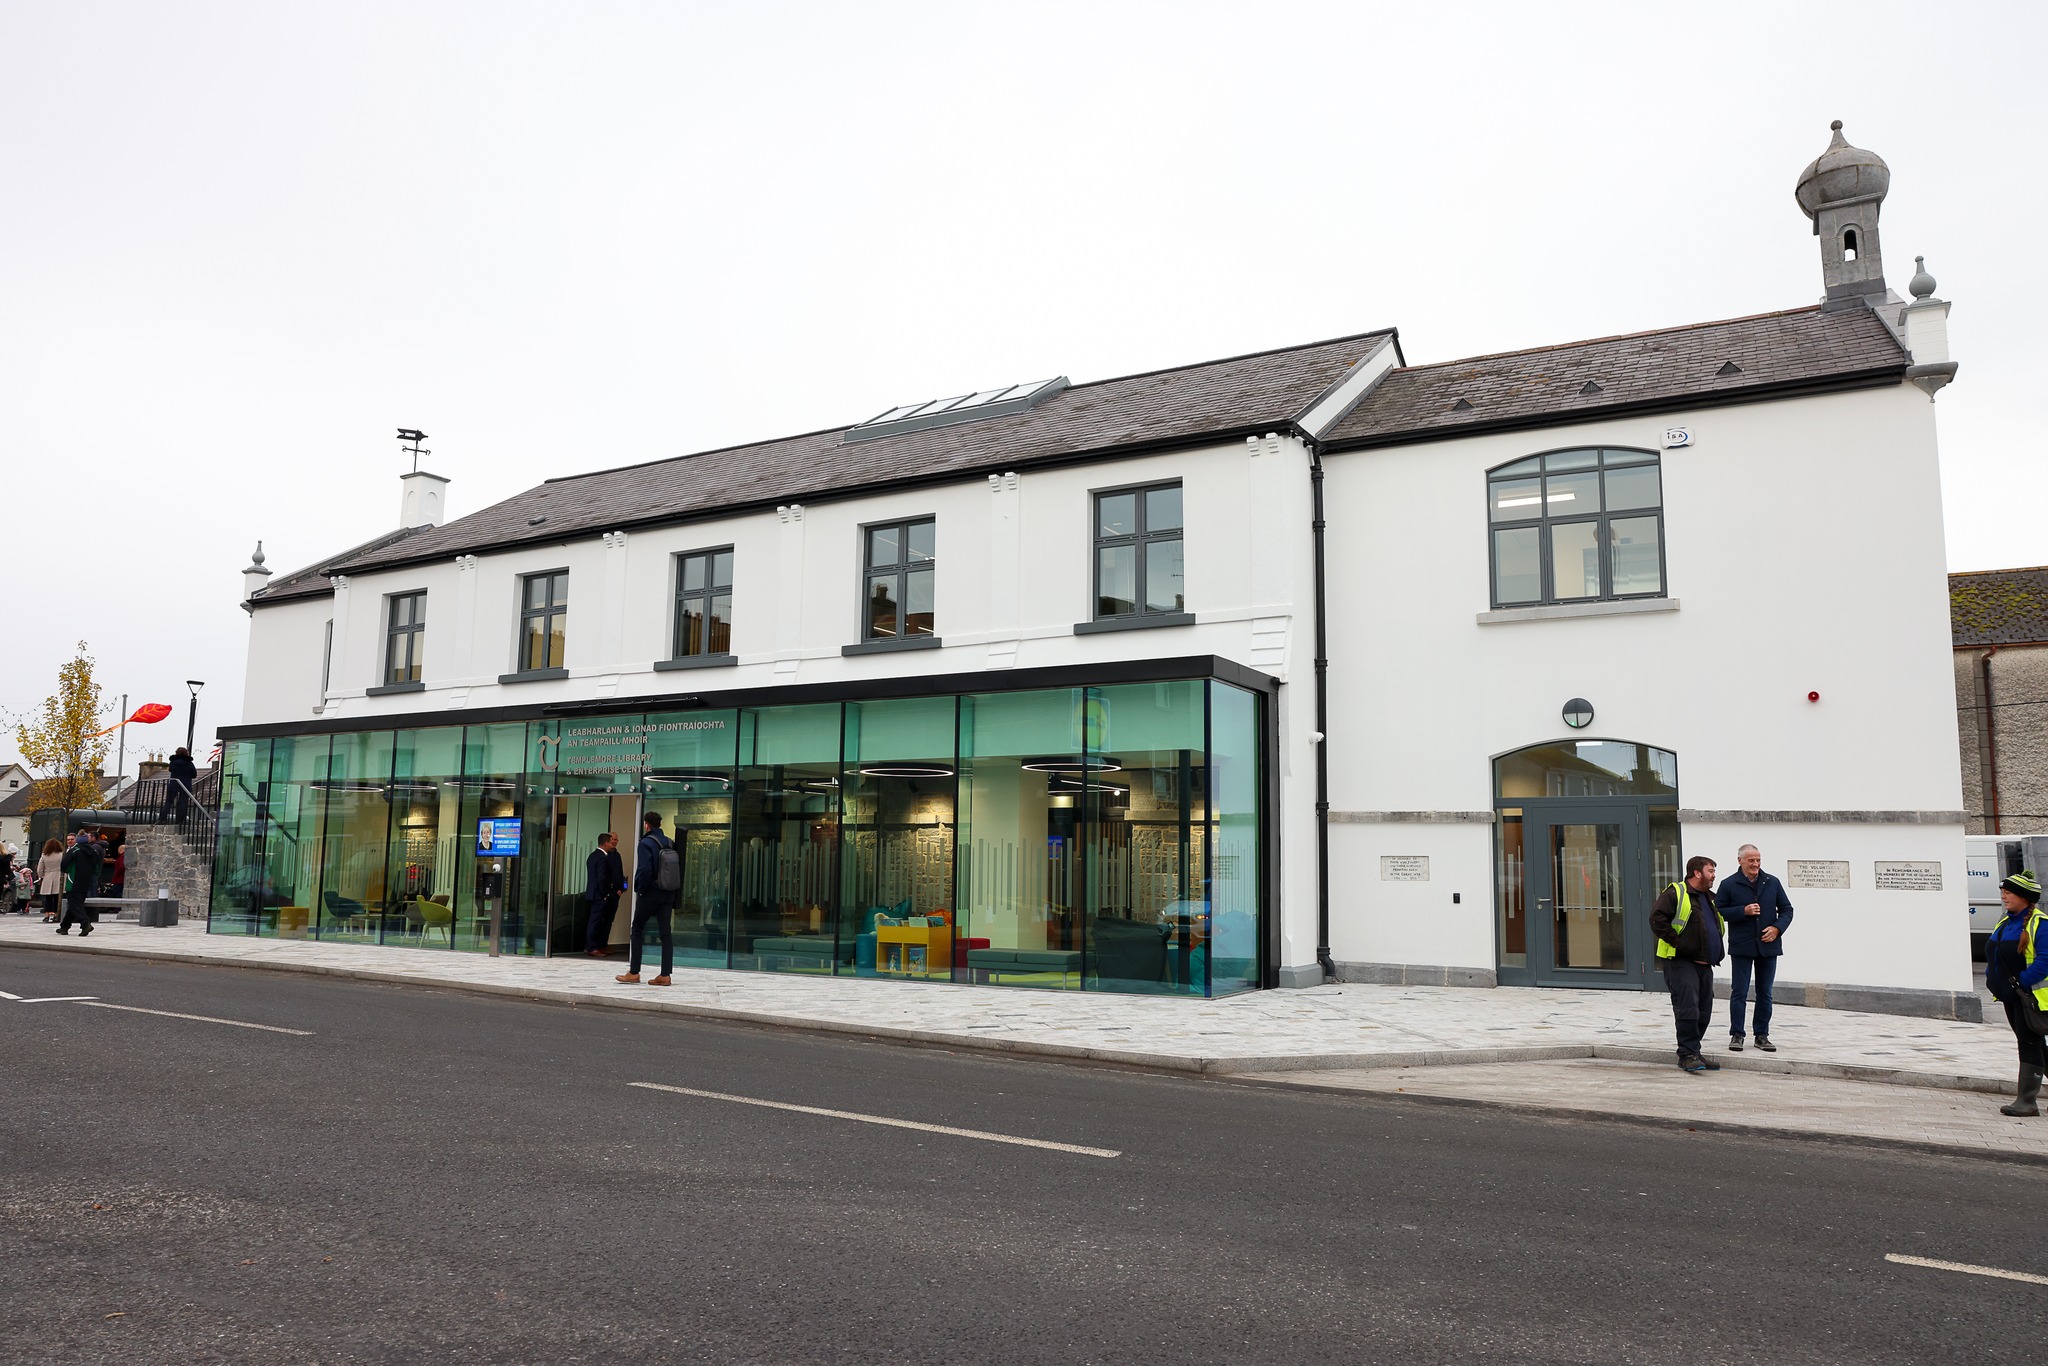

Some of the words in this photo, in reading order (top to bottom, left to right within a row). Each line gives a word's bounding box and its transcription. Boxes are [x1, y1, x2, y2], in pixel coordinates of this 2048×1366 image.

[568, 726, 622, 736] LEABHARLANN
[624, 725, 630, 733] &
[632, 724, 657, 733] IONAD
[659, 720, 725, 731] FIONTRAÍOCHTA
[568, 739, 578, 747] AN
[580, 737, 621, 747] TEAMPAILL
[568, 754, 616, 764] TEMPLEMORE
[618, 753, 652, 763] LIBRARY
[566, 767, 572, 775] &
[573, 766, 620, 775] ENTERPRISE
[621, 764, 653, 773] CENTRE
